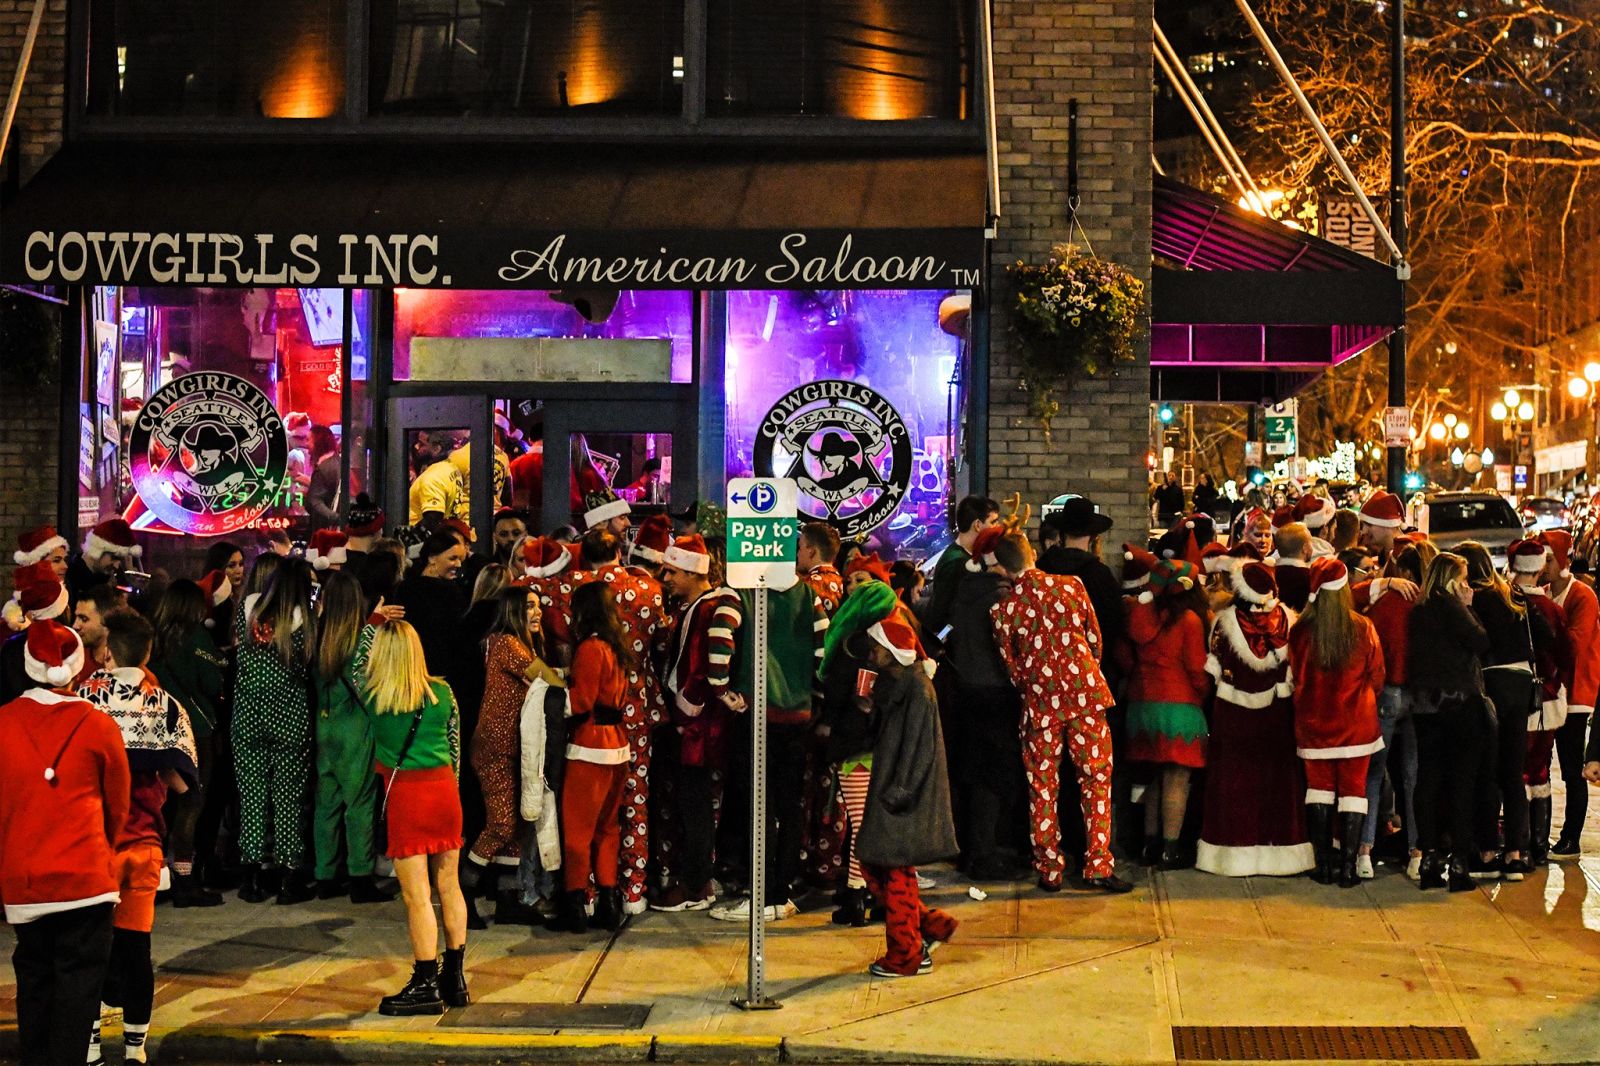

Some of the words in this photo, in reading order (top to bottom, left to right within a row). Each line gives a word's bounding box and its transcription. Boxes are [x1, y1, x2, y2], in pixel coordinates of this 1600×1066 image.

[24, 231, 321, 285] COWGIRLS
[338, 233, 453, 286] INC.
[497, 233, 758, 284] American
[765, 232, 946, 284] Saloon
[951, 269, 980, 286] TM
[139, 374, 249, 432] COWGIRLS
[248, 391, 282, 439] INC.
[171, 402, 249, 425] SEATTLE
[762, 381, 872, 438] COWGIRLS
[871, 398, 906, 445] INC.
[794, 409, 872, 432] SEATTLE
[1275, 418, 1285, 432] 2
[198, 485, 219, 495] WA
[823, 490, 844, 500] WA
[223, 495, 270, 529] Saloon
[847, 499, 895, 535] Saloon
[731, 521, 767, 541] Pay
[773, 521, 793, 538] to
[740, 541, 784, 557] Park
